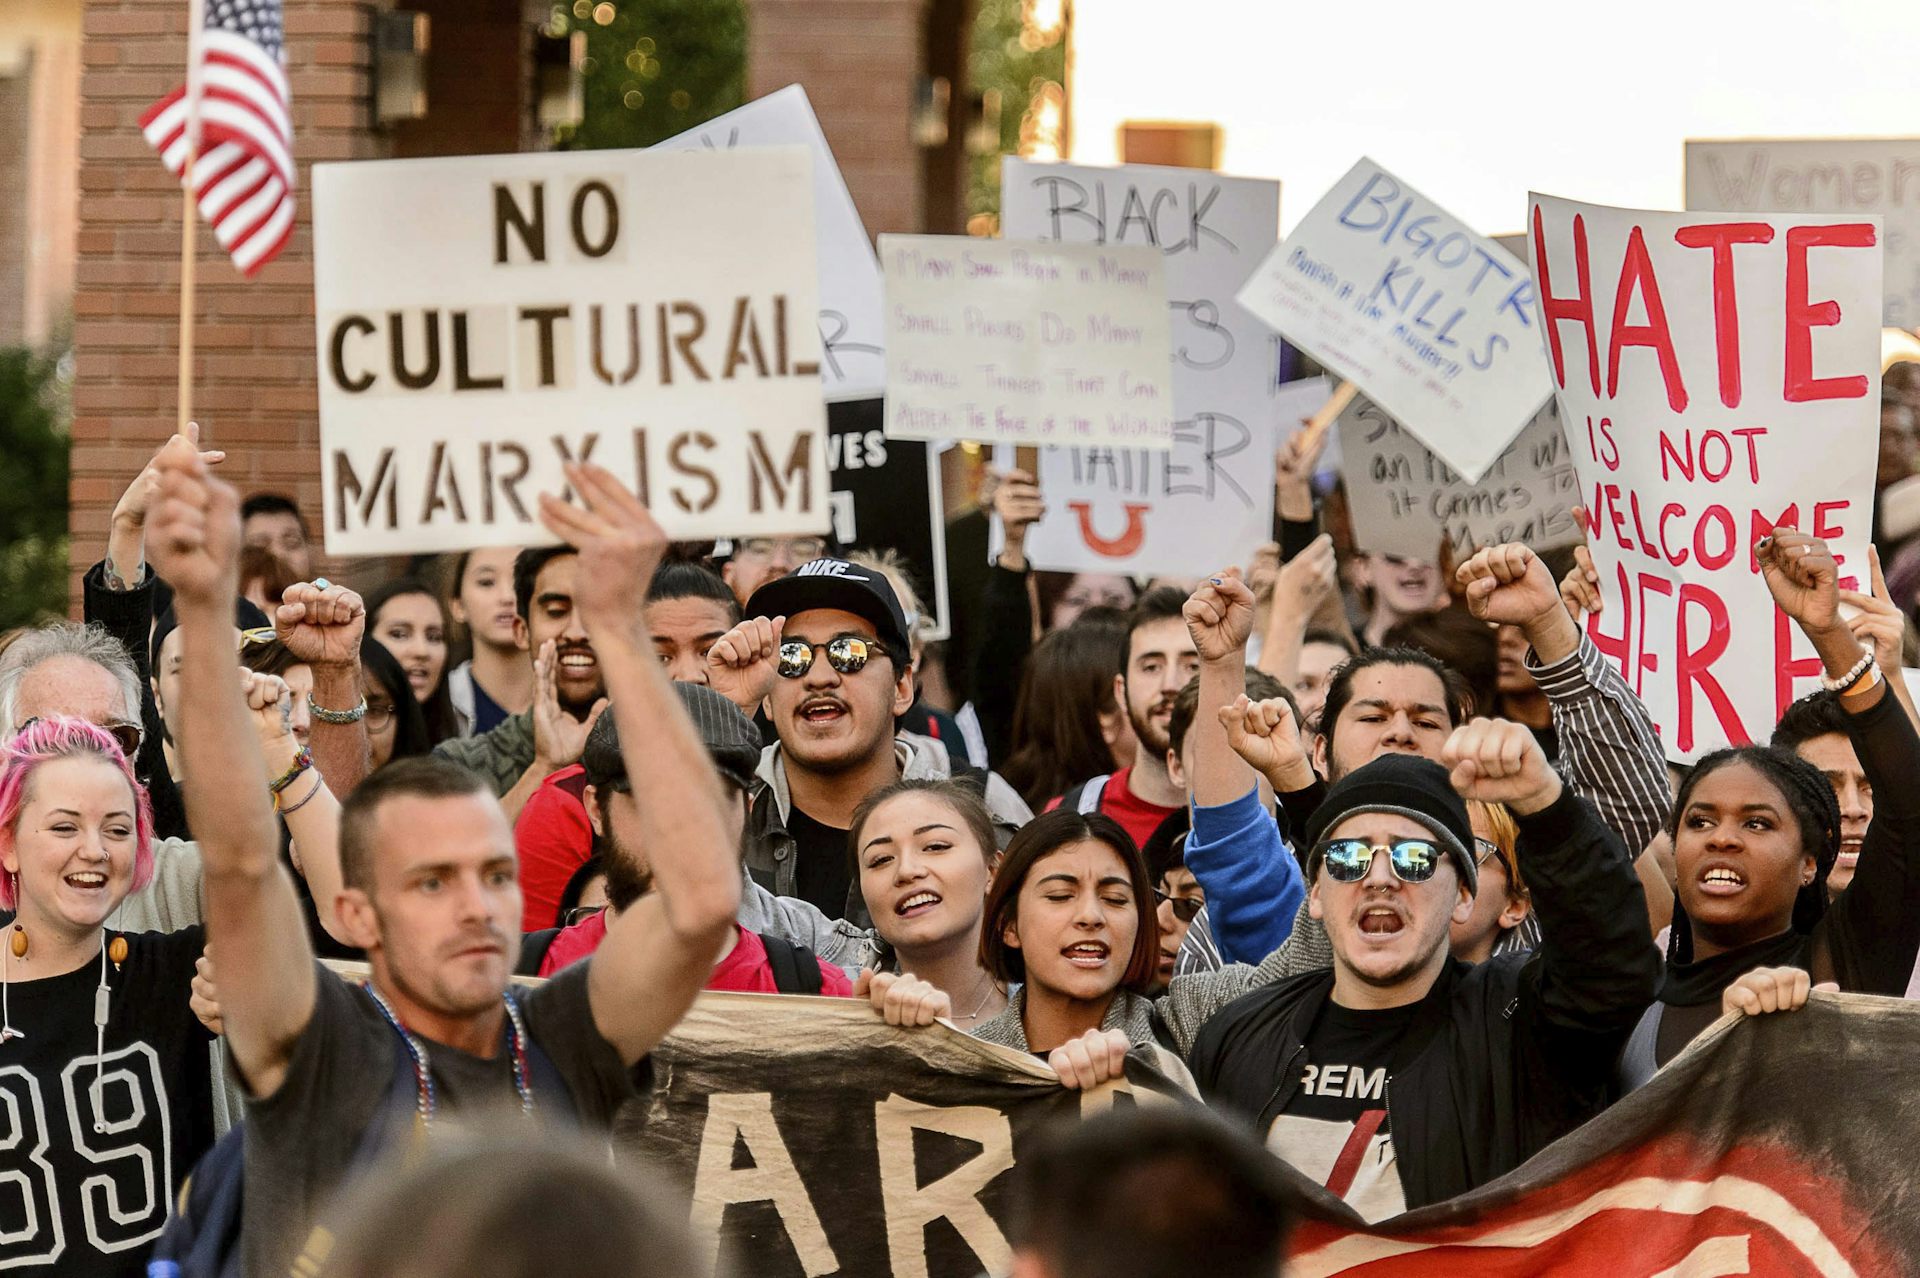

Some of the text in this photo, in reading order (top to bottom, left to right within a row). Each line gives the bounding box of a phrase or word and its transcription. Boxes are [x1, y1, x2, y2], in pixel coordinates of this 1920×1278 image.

[491, 179, 621, 265] NO
[1338, 172, 1537, 327] BIGOTR
[328, 294, 821, 393] CULTURAL
[1369, 256, 1511, 372] KILLS
[1533, 202, 1878, 413] HATE
[333, 428, 818, 533] MARXISM
[1587, 415, 1620, 472] IS
[1660, 426, 1768, 485] NOT
[797, 559, 852, 578] NIKE
[1574, 481, 1851, 574] WELCOME
[690, 1078, 1138, 1278] AR
